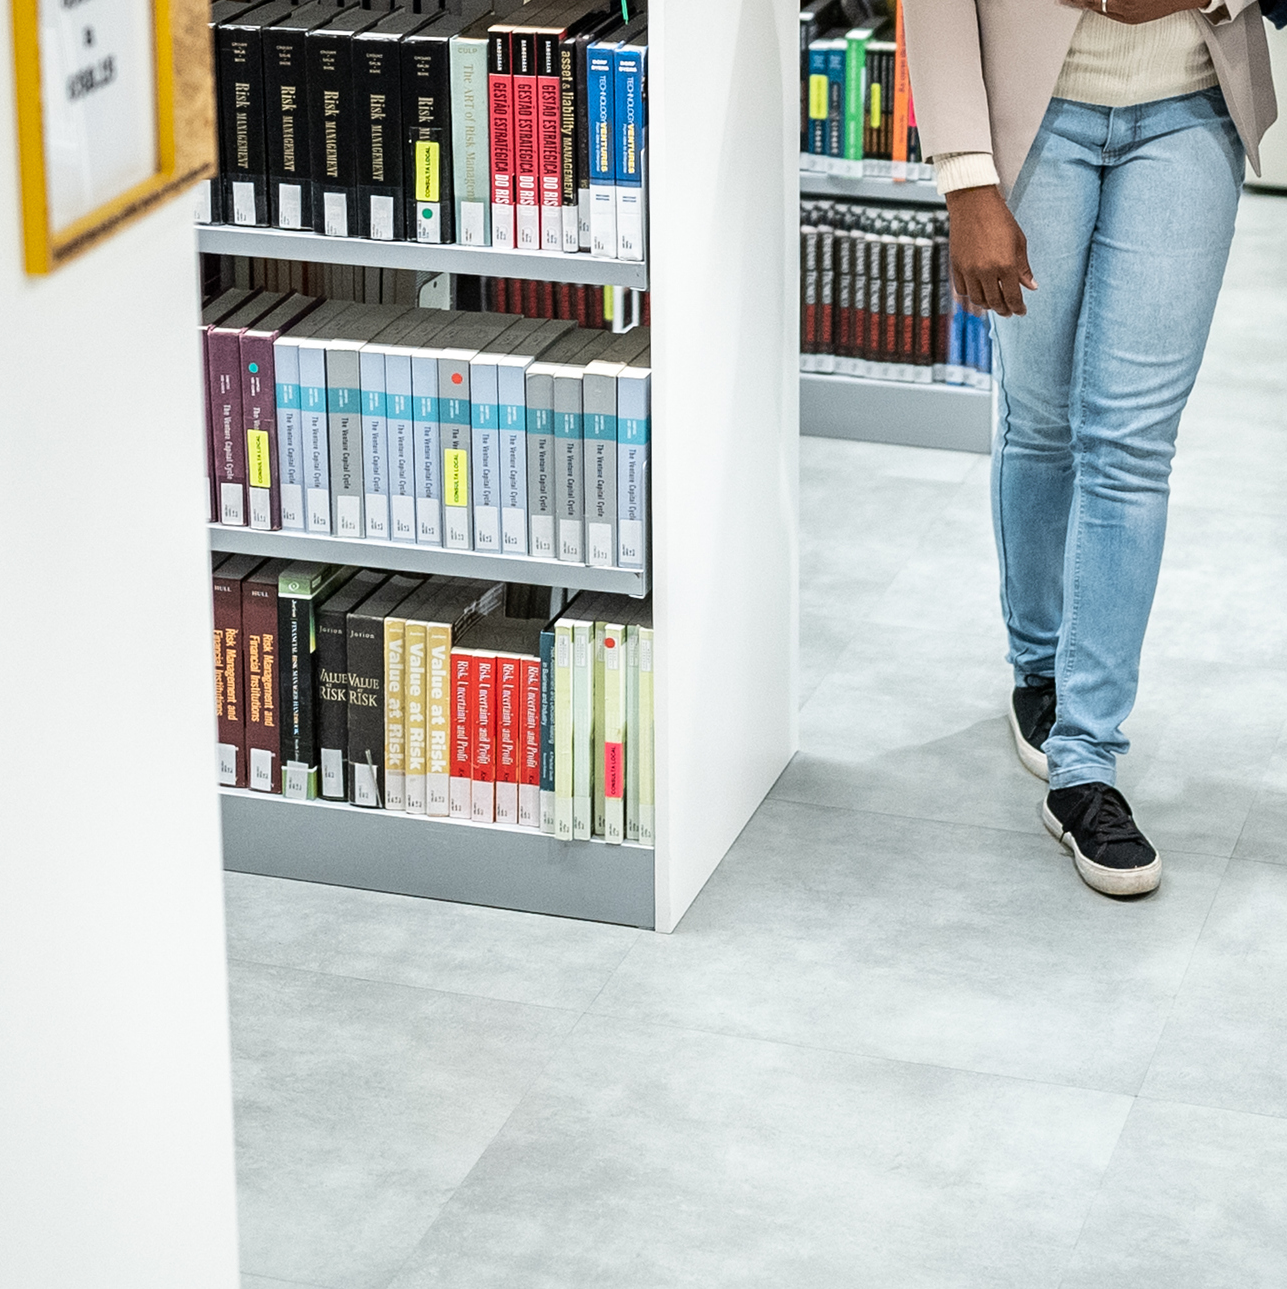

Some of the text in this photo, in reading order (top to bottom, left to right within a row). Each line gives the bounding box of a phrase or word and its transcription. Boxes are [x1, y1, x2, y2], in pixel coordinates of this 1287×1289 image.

[561, 51, 573, 81] asset
[235, 82, 250, 168] Risk MANAGEMENT
[561, 92, 575, 134] liability
[280, 85, 297, 171] Risk MANAGEMENT
[324, 91, 339, 177] Risk MANAGEMENT
[493, 82, 511, 186] GESTÃO ESTRATÉGICA DO
[542, 85, 560, 188] GESTÃO ESTRATÉGICA DO
[563, 137, 573, 199] MANAGEMENT
[538, 439, 546, 448] The
[596, 444, 604, 454] The
[342, 453, 350, 473] Capital
[342, 475, 351, 489] Cycle
[538, 474, 547, 494] Capital
[596, 480, 605, 500] Capital
[539, 495, 547, 511] Cycle
[596, 501, 605, 517] Cycle
[350, 630, 375, 639] Jorion
[225, 628, 238, 720] Risk Management and
[249, 635, 262, 722] Financial Institutions
[262, 634, 275, 727] Risk Management and
[348, 673, 380, 690] VALUE
[320, 686, 347, 702] RISK
[349, 690, 378, 708] RISK
[389, 639, 404, 766] Value at Risk
[409, 643, 424, 770] Value at Risk
[432, 646, 447, 773] Value at Risk
[457, 725, 467, 738] and
[457, 739, 469, 762] Profit
